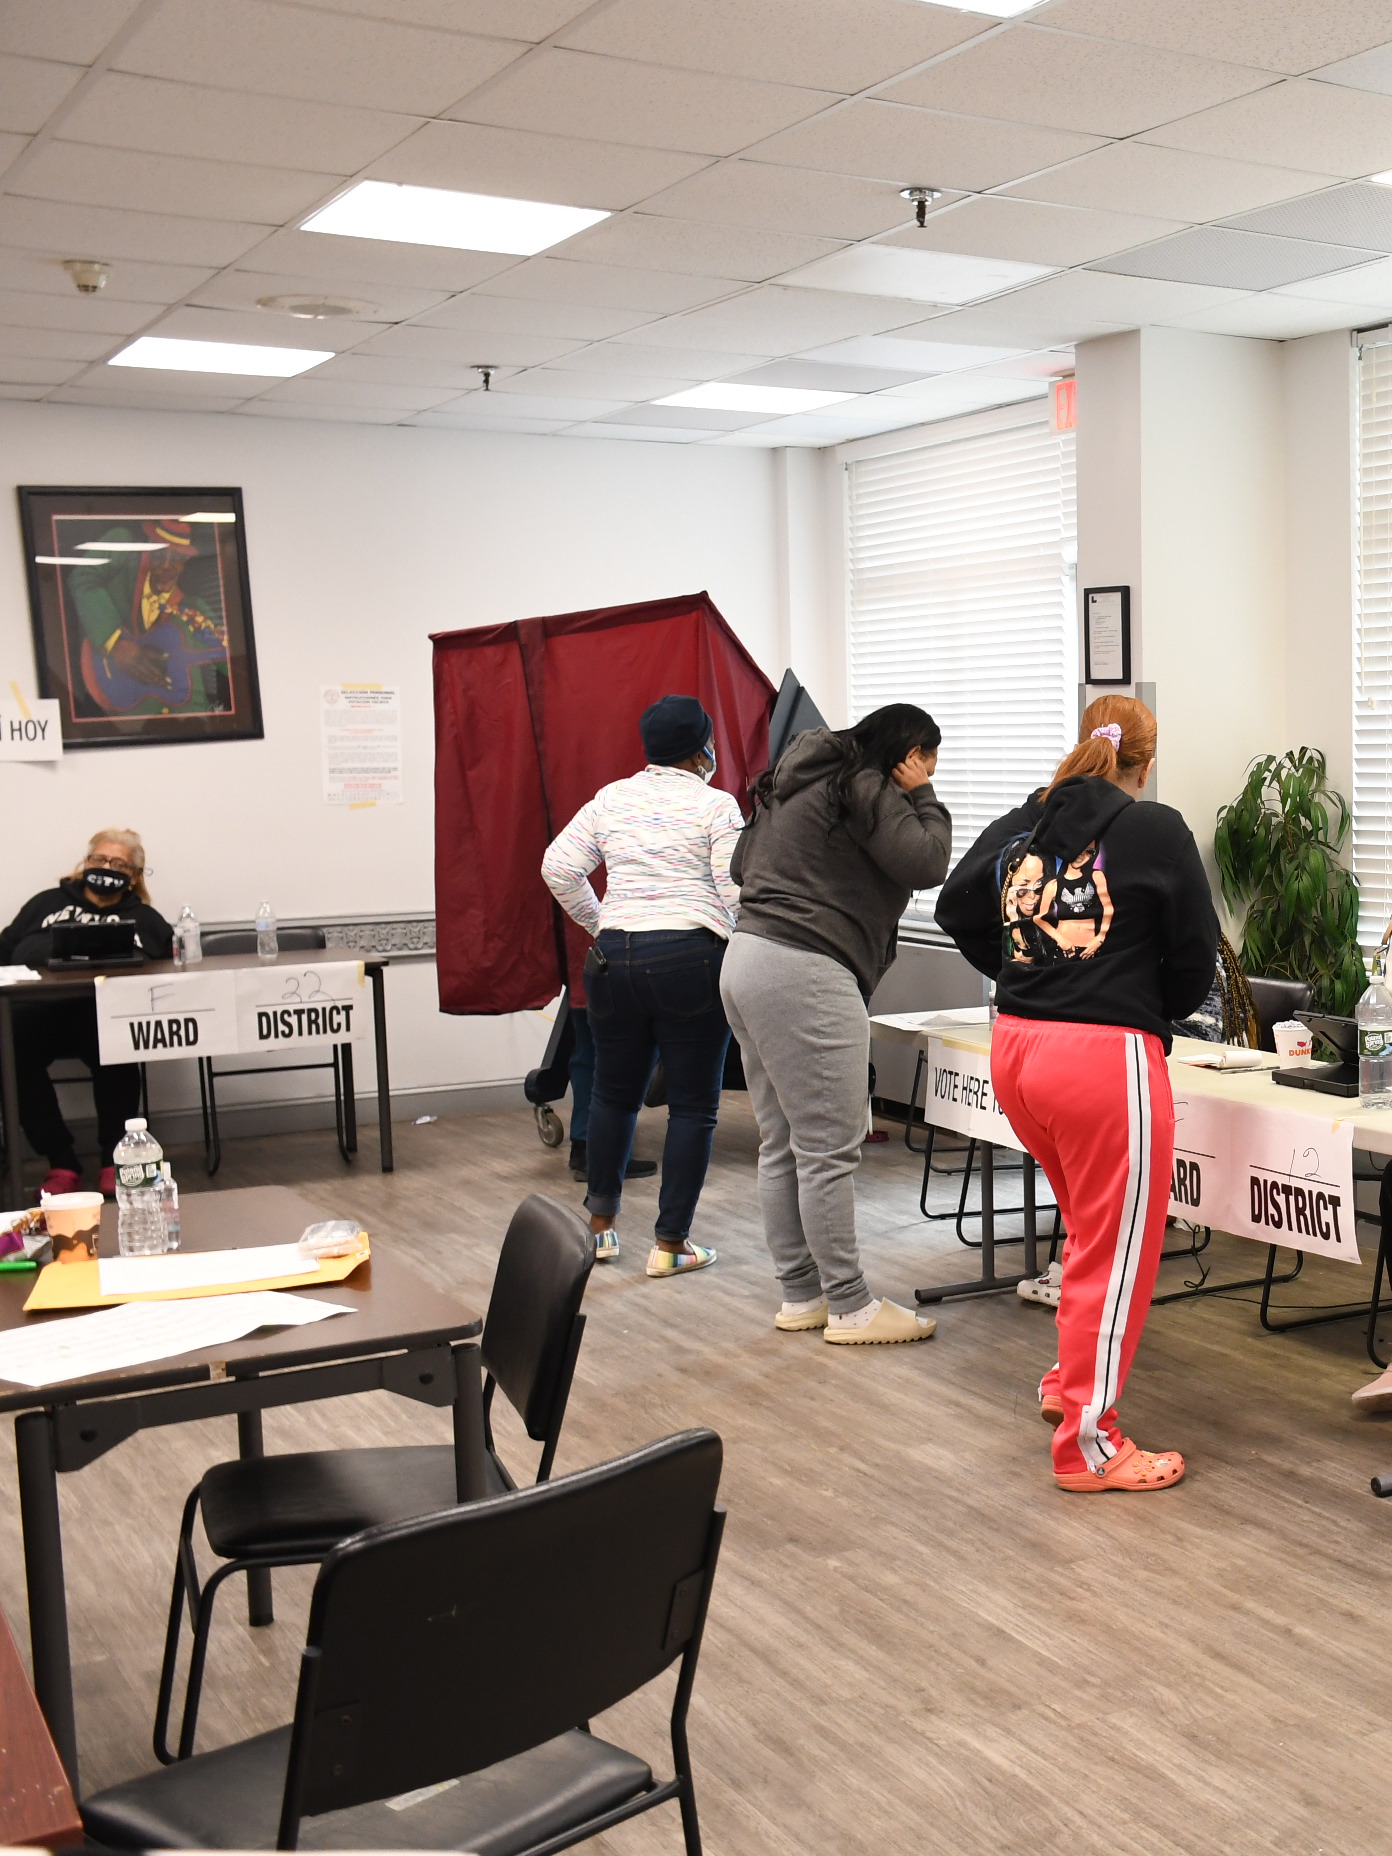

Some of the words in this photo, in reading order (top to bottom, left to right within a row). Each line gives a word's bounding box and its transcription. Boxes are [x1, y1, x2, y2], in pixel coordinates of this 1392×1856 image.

[10, 719, 49, 742] HOY
[129, 1017, 199, 1051] WARD
[256, 1004, 354, 1041] DISTRICT
[935, 1066, 960, 1104] VOTE
[960, 1074, 989, 1112] HERE
[1288, 1147, 1322, 1184] 12
[1250, 1175, 1342, 1244] DISTRICT
